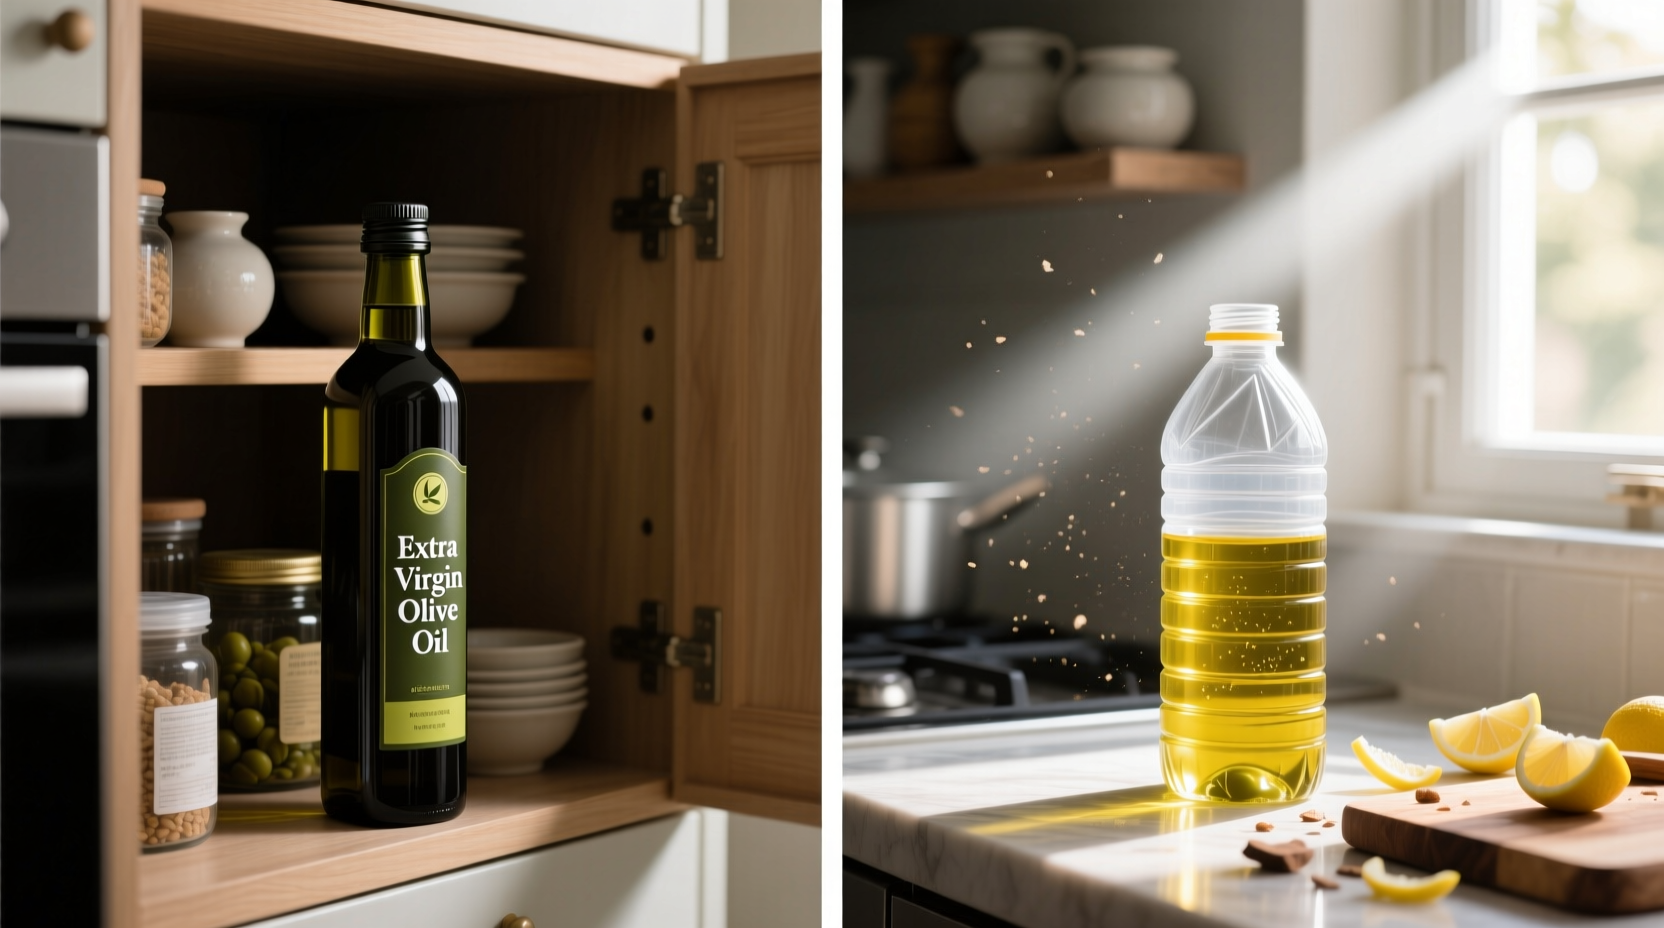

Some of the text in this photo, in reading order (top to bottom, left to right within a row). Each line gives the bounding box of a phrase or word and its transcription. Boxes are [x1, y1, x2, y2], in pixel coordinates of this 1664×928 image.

[397, 535, 458, 559] Extra
[393, 565, 463, 597] Virgin
[398, 598, 458, 623] Olive
[412, 628, 449, 655] Oil
